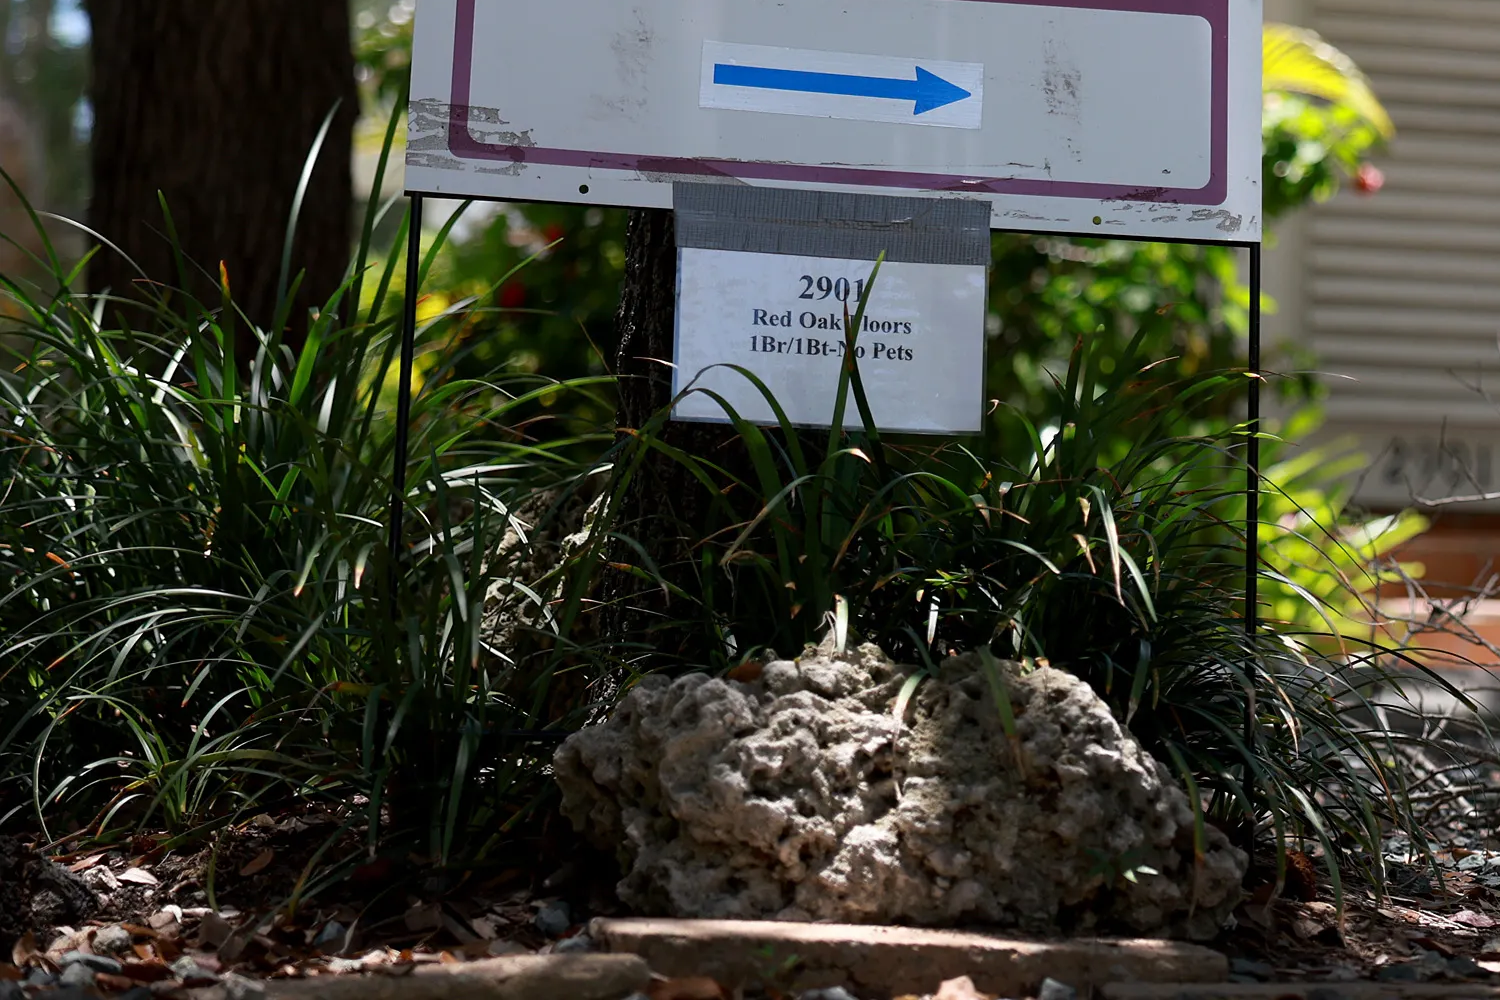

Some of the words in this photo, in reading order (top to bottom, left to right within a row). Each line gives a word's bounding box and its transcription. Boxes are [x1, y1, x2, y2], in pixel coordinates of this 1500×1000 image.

[798, 274, 865, 303] 2901
[752, 308, 792, 328] Red
[799, 311, 842, 331] Oak
[872, 342, 913, 361] Pets
